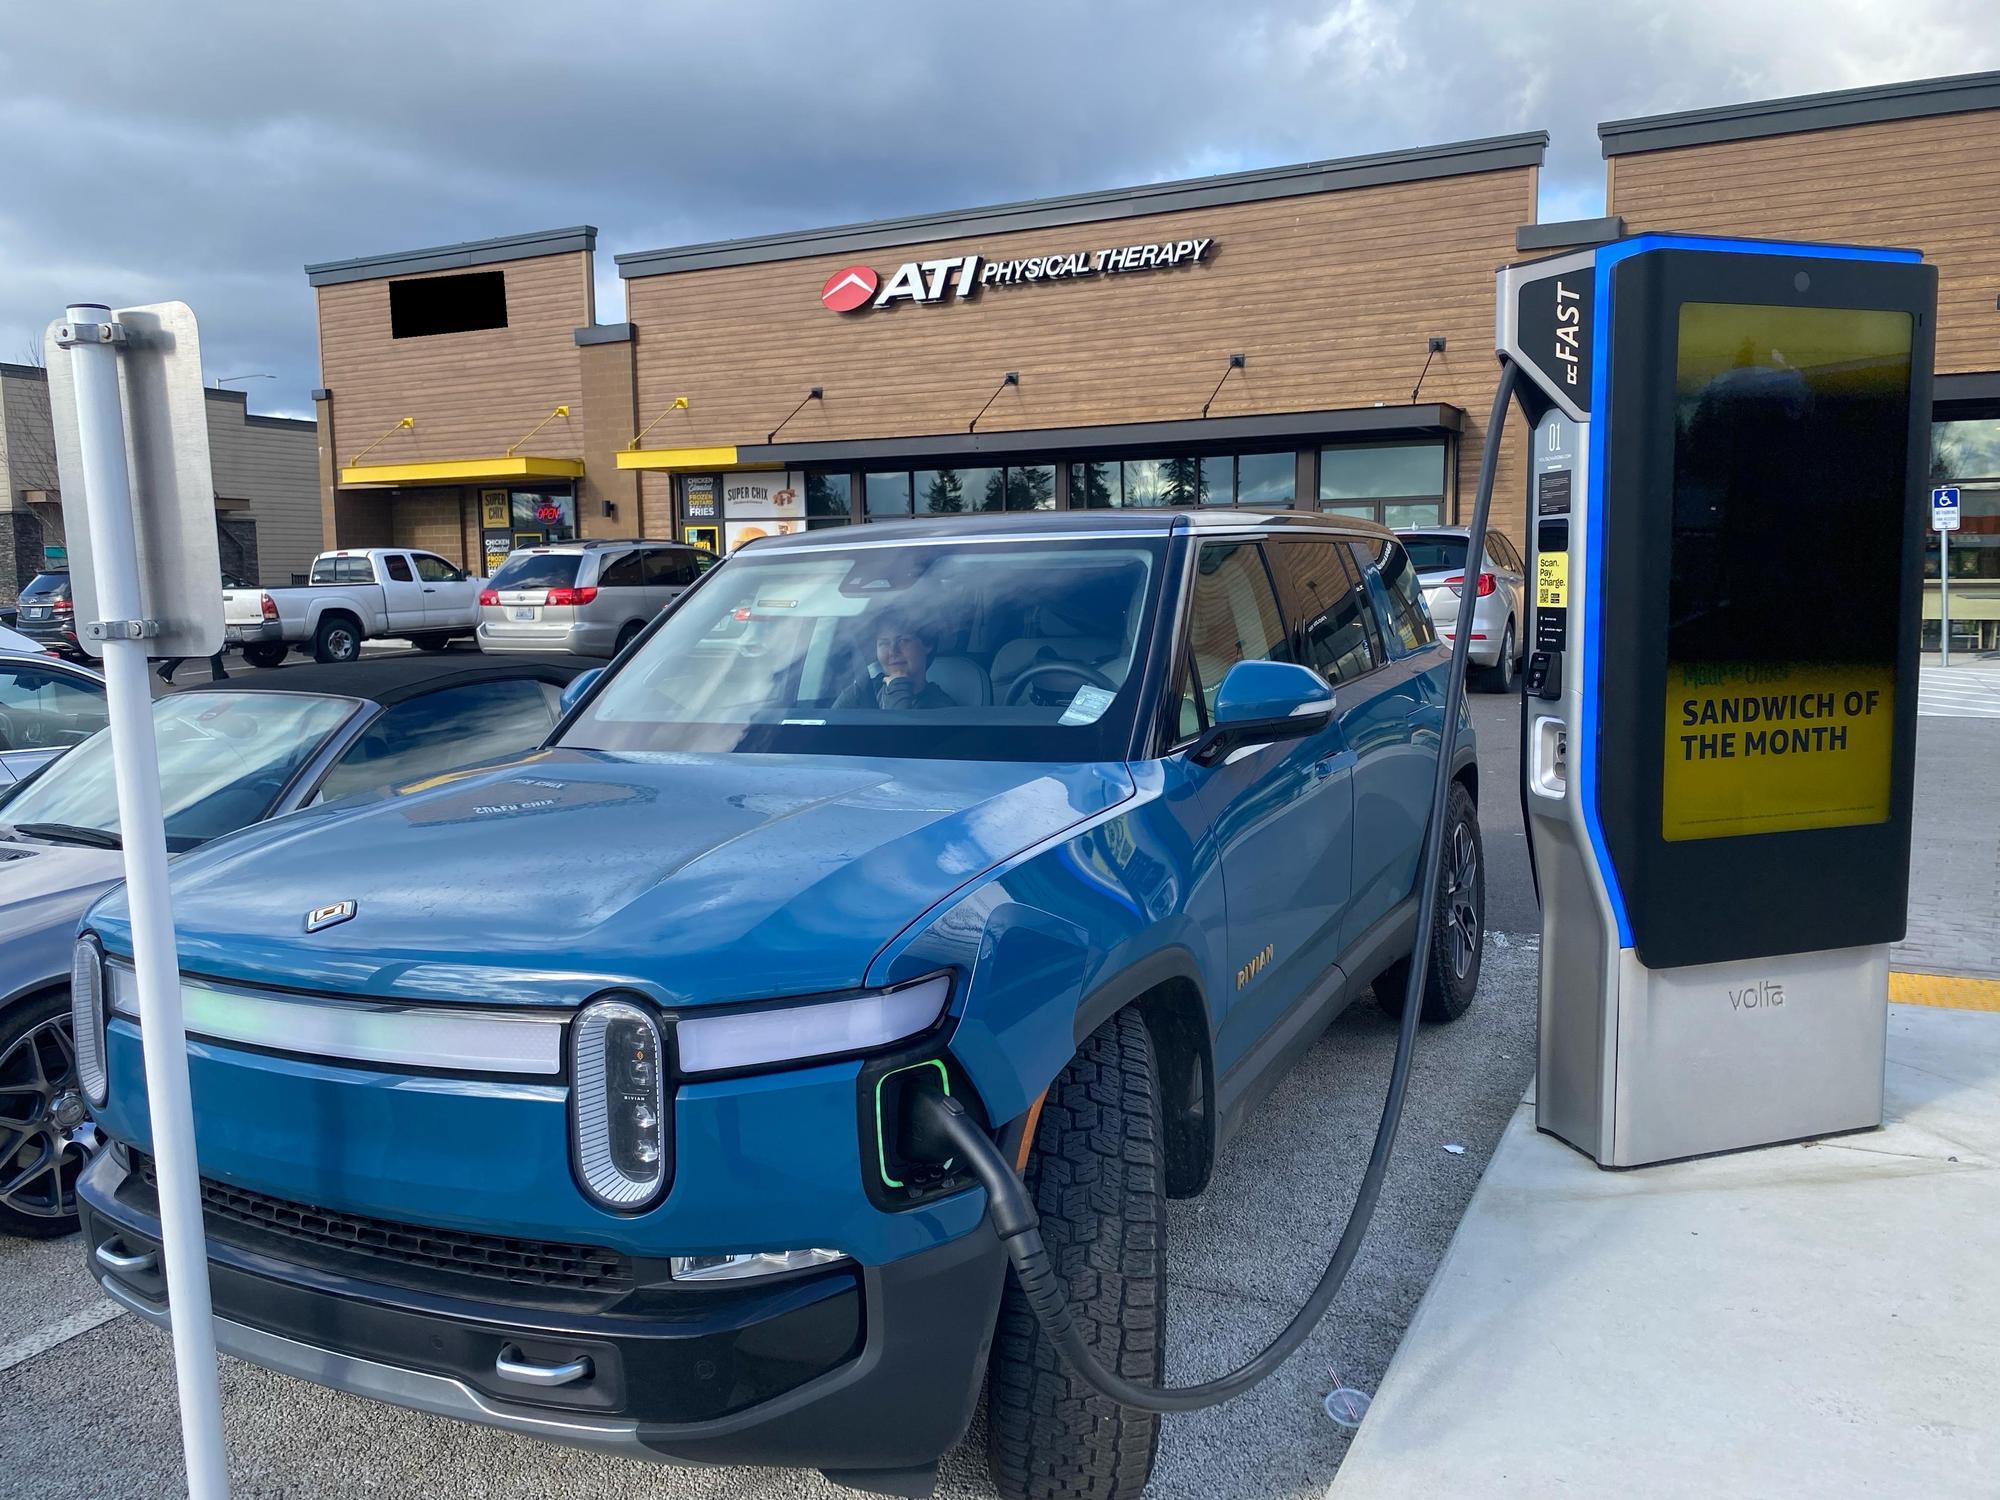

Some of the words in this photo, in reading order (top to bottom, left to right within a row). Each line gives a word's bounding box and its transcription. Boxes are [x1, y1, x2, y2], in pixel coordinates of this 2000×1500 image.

[873, 255, 981, 307] ATI
[982, 250, 1090, 284] PHYSICAL
[1096, 237, 1214, 273] THERAPY
[1555, 281, 1580, 363] FAST
[1549, 423, 1561, 451] 01
[485, 494, 507, 506] SUPER
[727, 486, 750, 501] SUPER
[751, 486, 768, 501] CHIX
[488, 507, 504, 520] CHIX
[537, 508, 559, 519] OPEN
[689, 507, 714, 516] FRIES
[1540, 559, 1560, 567] Scan.
[1540, 569, 1554, 578] Pay.
[1540, 578, 1566, 589] Charge.
[1683, 693, 1834, 726] SANDWICH
[1844, 691, 1880, 716] OF
[1680, 733, 1736, 760] THE
[1744, 726, 1848, 757] MONTH
[1236, 943, 1273, 991] RIVIAN
[1728, 980, 1783, 1010] volta
